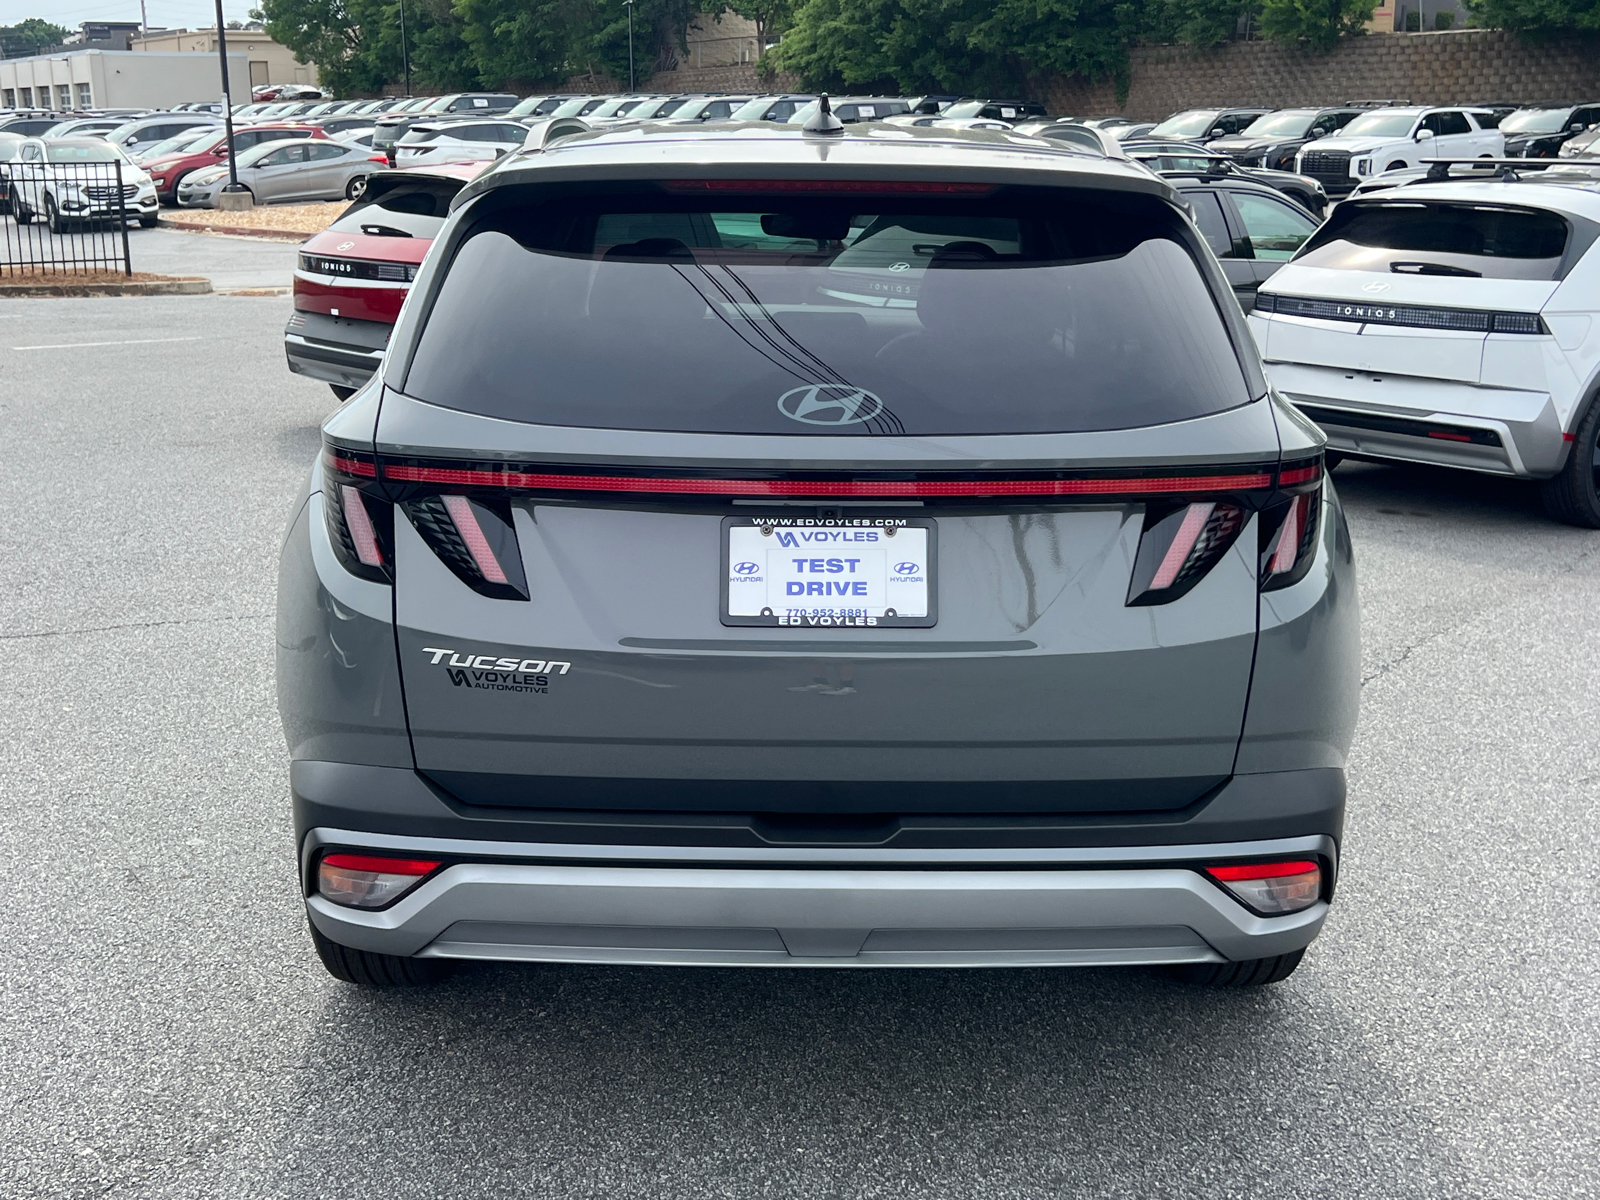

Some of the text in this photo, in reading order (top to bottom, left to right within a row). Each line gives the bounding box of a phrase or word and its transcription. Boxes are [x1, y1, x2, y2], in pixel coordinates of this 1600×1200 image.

[752, 517, 907, 526] WWW.EDVOYLES.COM
[800, 531, 879, 542] VOYLES
[792, 558, 861, 573] TEST
[786, 581, 868, 596] DRIVE
[785, 608, 868, 617] 770-952-8881
[778, 616, 878, 626] ED VOYLES
[471, 670, 549, 686] VOYLES
[473, 682, 549, 694] AUTOMOTIVE
